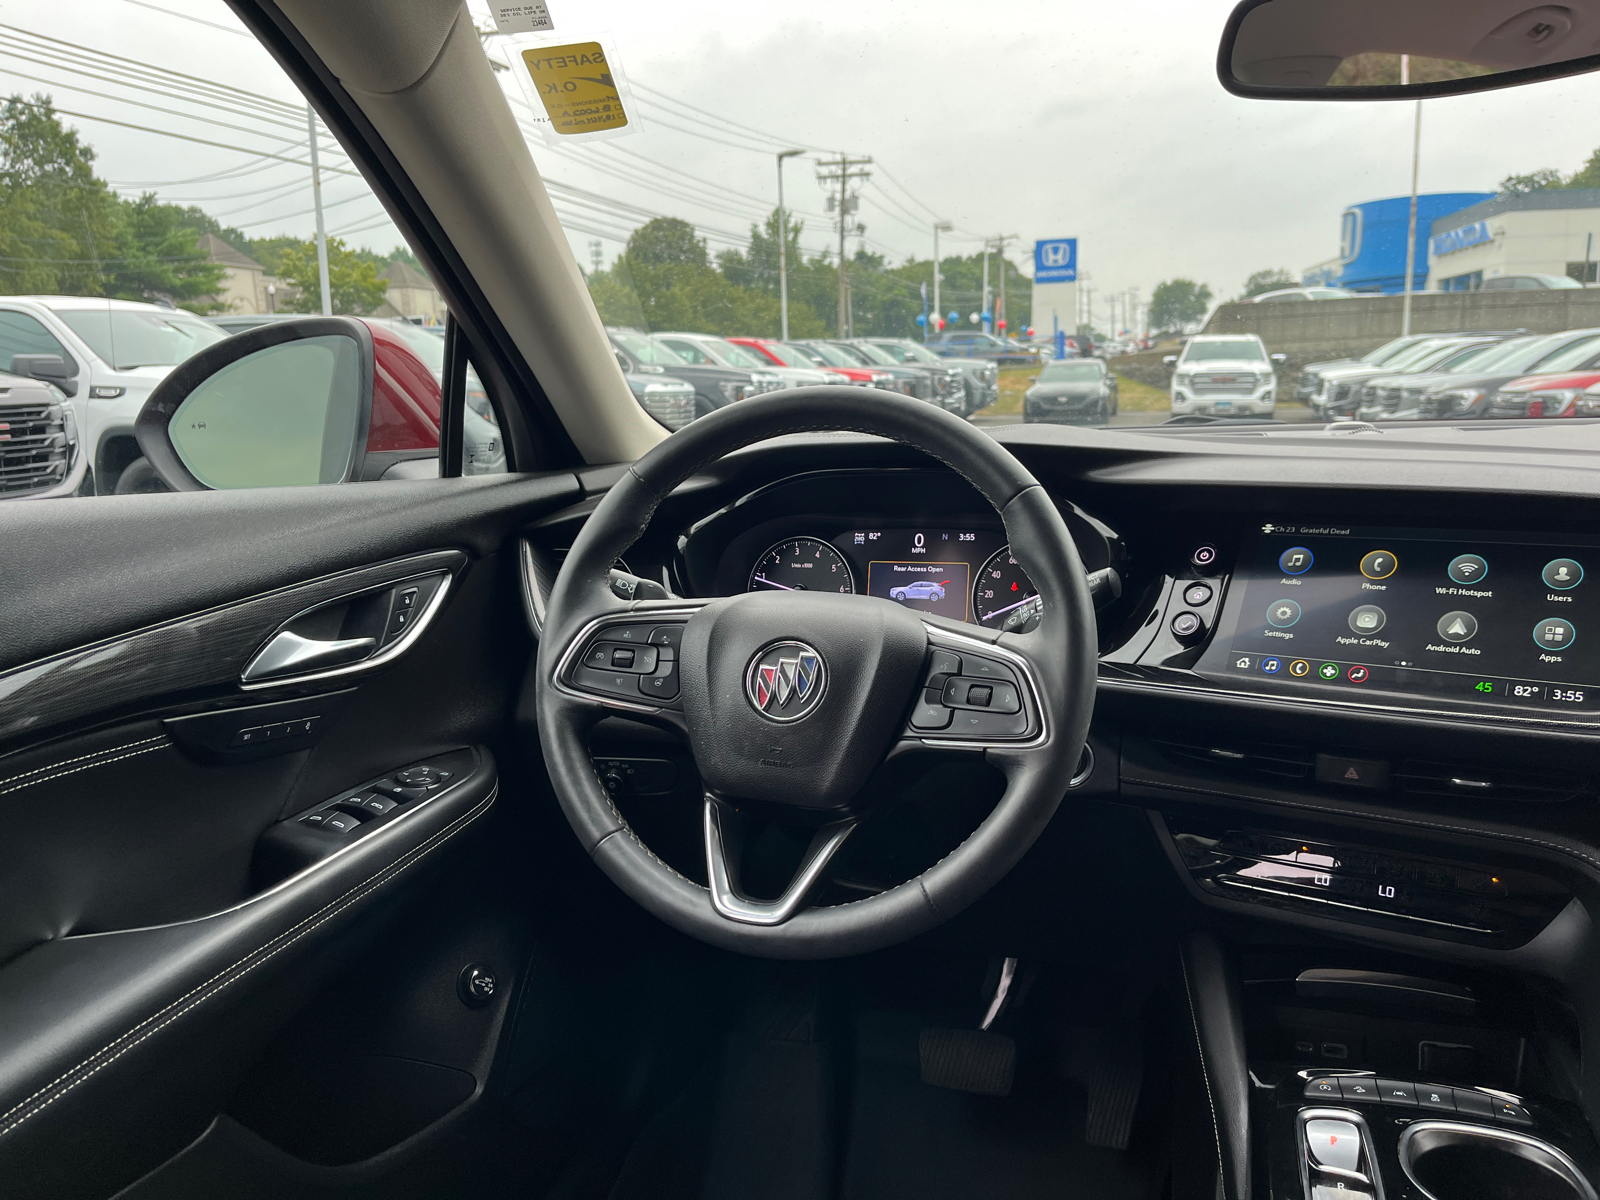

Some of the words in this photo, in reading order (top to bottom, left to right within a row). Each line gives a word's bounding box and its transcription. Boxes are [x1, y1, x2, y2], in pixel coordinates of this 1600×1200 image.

[1300, 526, 1329, 534] Grateful
[914, 533, 924, 547] 0
[794, 547, 800, 556] 3
[815, 550, 820, 558] 4
[775, 555, 780, 564] 2
[831, 564, 837, 572] 5
[991, 570, 1001, 579] 40
[839, 585, 845, 593] 6
[1361, 583, 1387, 591] Phone
[985, 590, 994, 598] 20
[1435, 587, 1457, 595] Wi-Fi
[1458, 588, 1493, 598] Hotspot
[1547, 594, 1572, 602] Users
[1264, 630, 1294, 639] Settings
[1336, 636, 1358, 645] Apple
[1360, 638, 1390, 648] CarPlay
[1426, 644, 1459, 653] Android
[1460, 646, 1481, 655] Auto
[1539, 654, 1562, 663] Apps
[1475, 682, 1493, 693] 45
[1514, 685, 1539, 697] 82°
[1552, 690, 1584, 702] 3:55
[1378, 884, 1395, 898] LO
[1330, 1136, 1337, 1145] P
[1337, 1182, 1345, 1190] R
